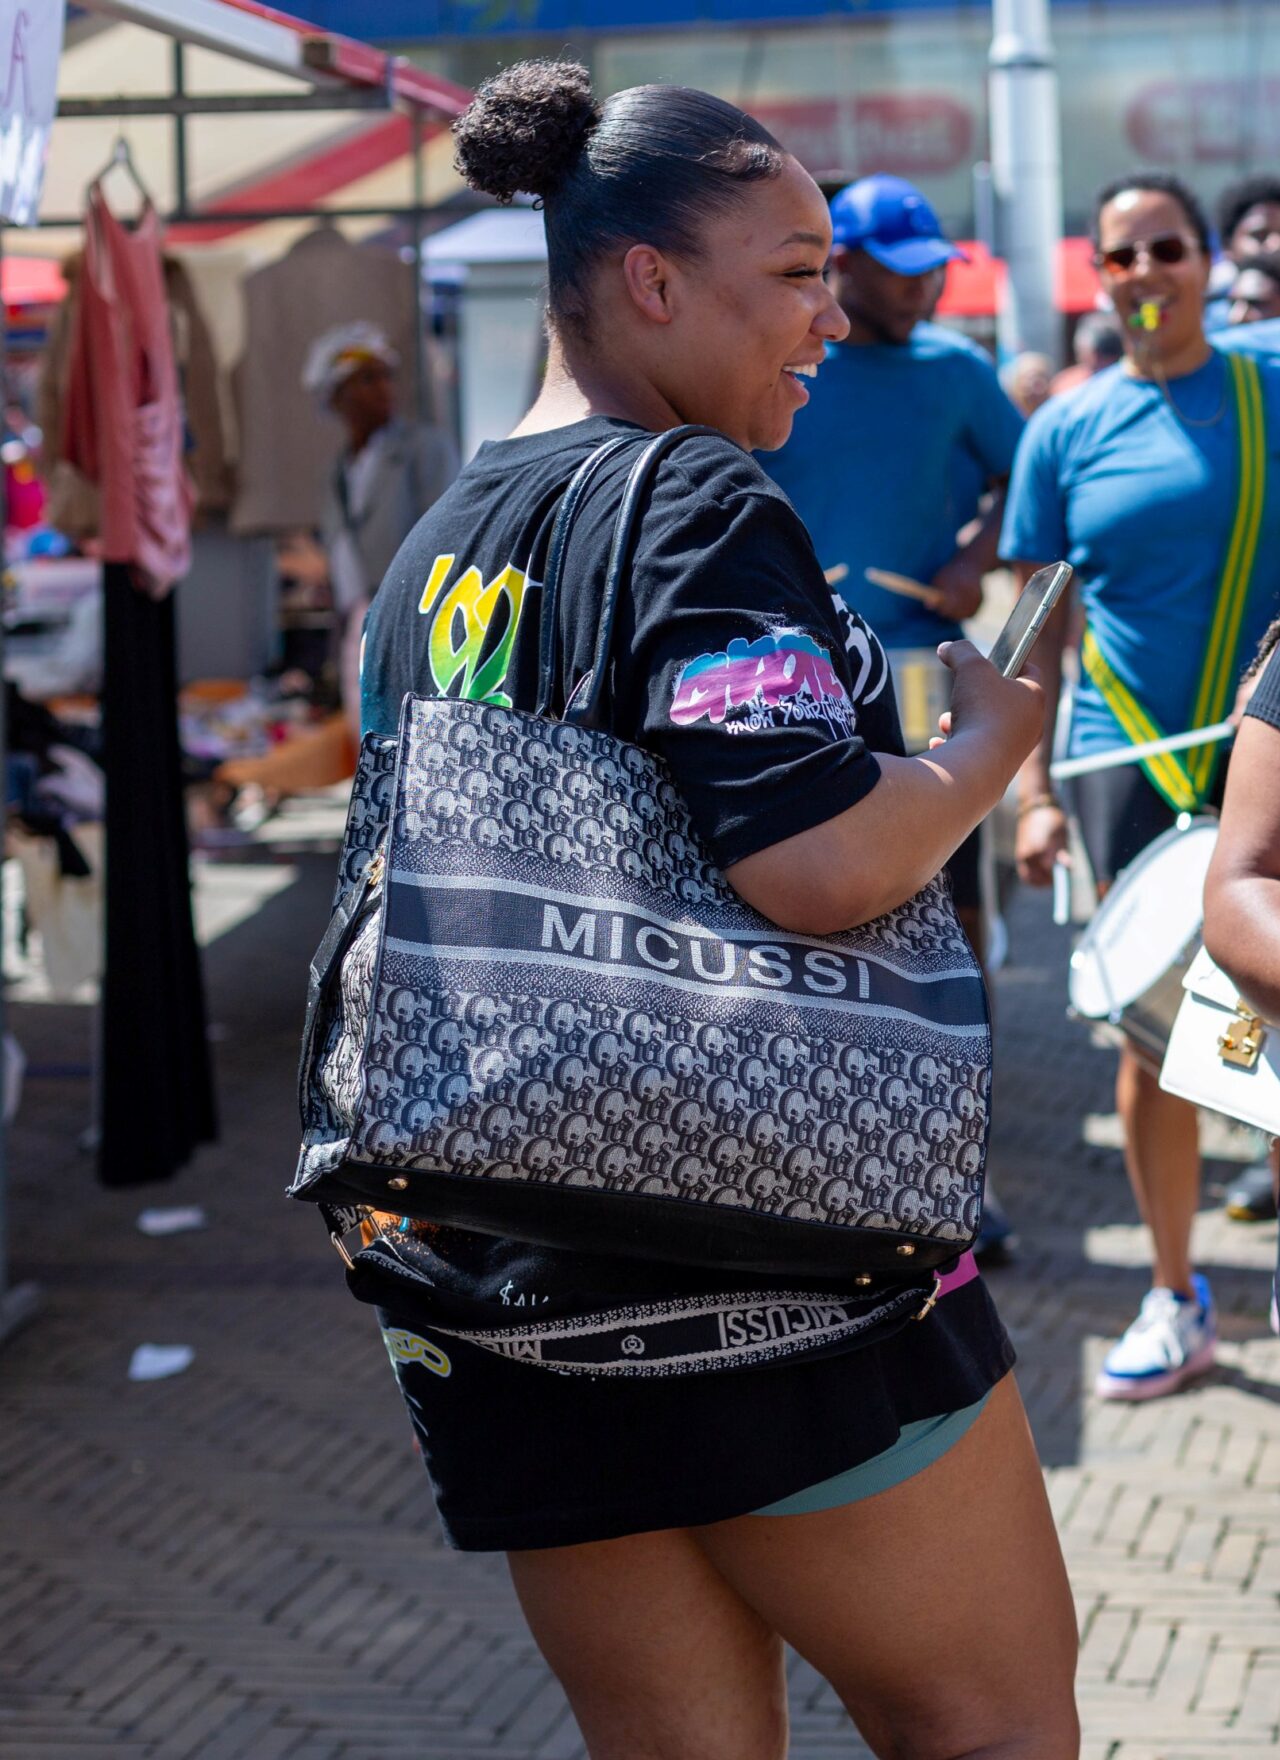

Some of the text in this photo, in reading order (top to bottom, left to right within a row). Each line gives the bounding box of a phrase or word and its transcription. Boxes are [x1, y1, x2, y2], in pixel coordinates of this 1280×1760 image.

[725, 711, 776, 735] KNOW
[541, 904, 870, 999] MICUSSI
[719, 1303, 849, 1348] MICUSSI
